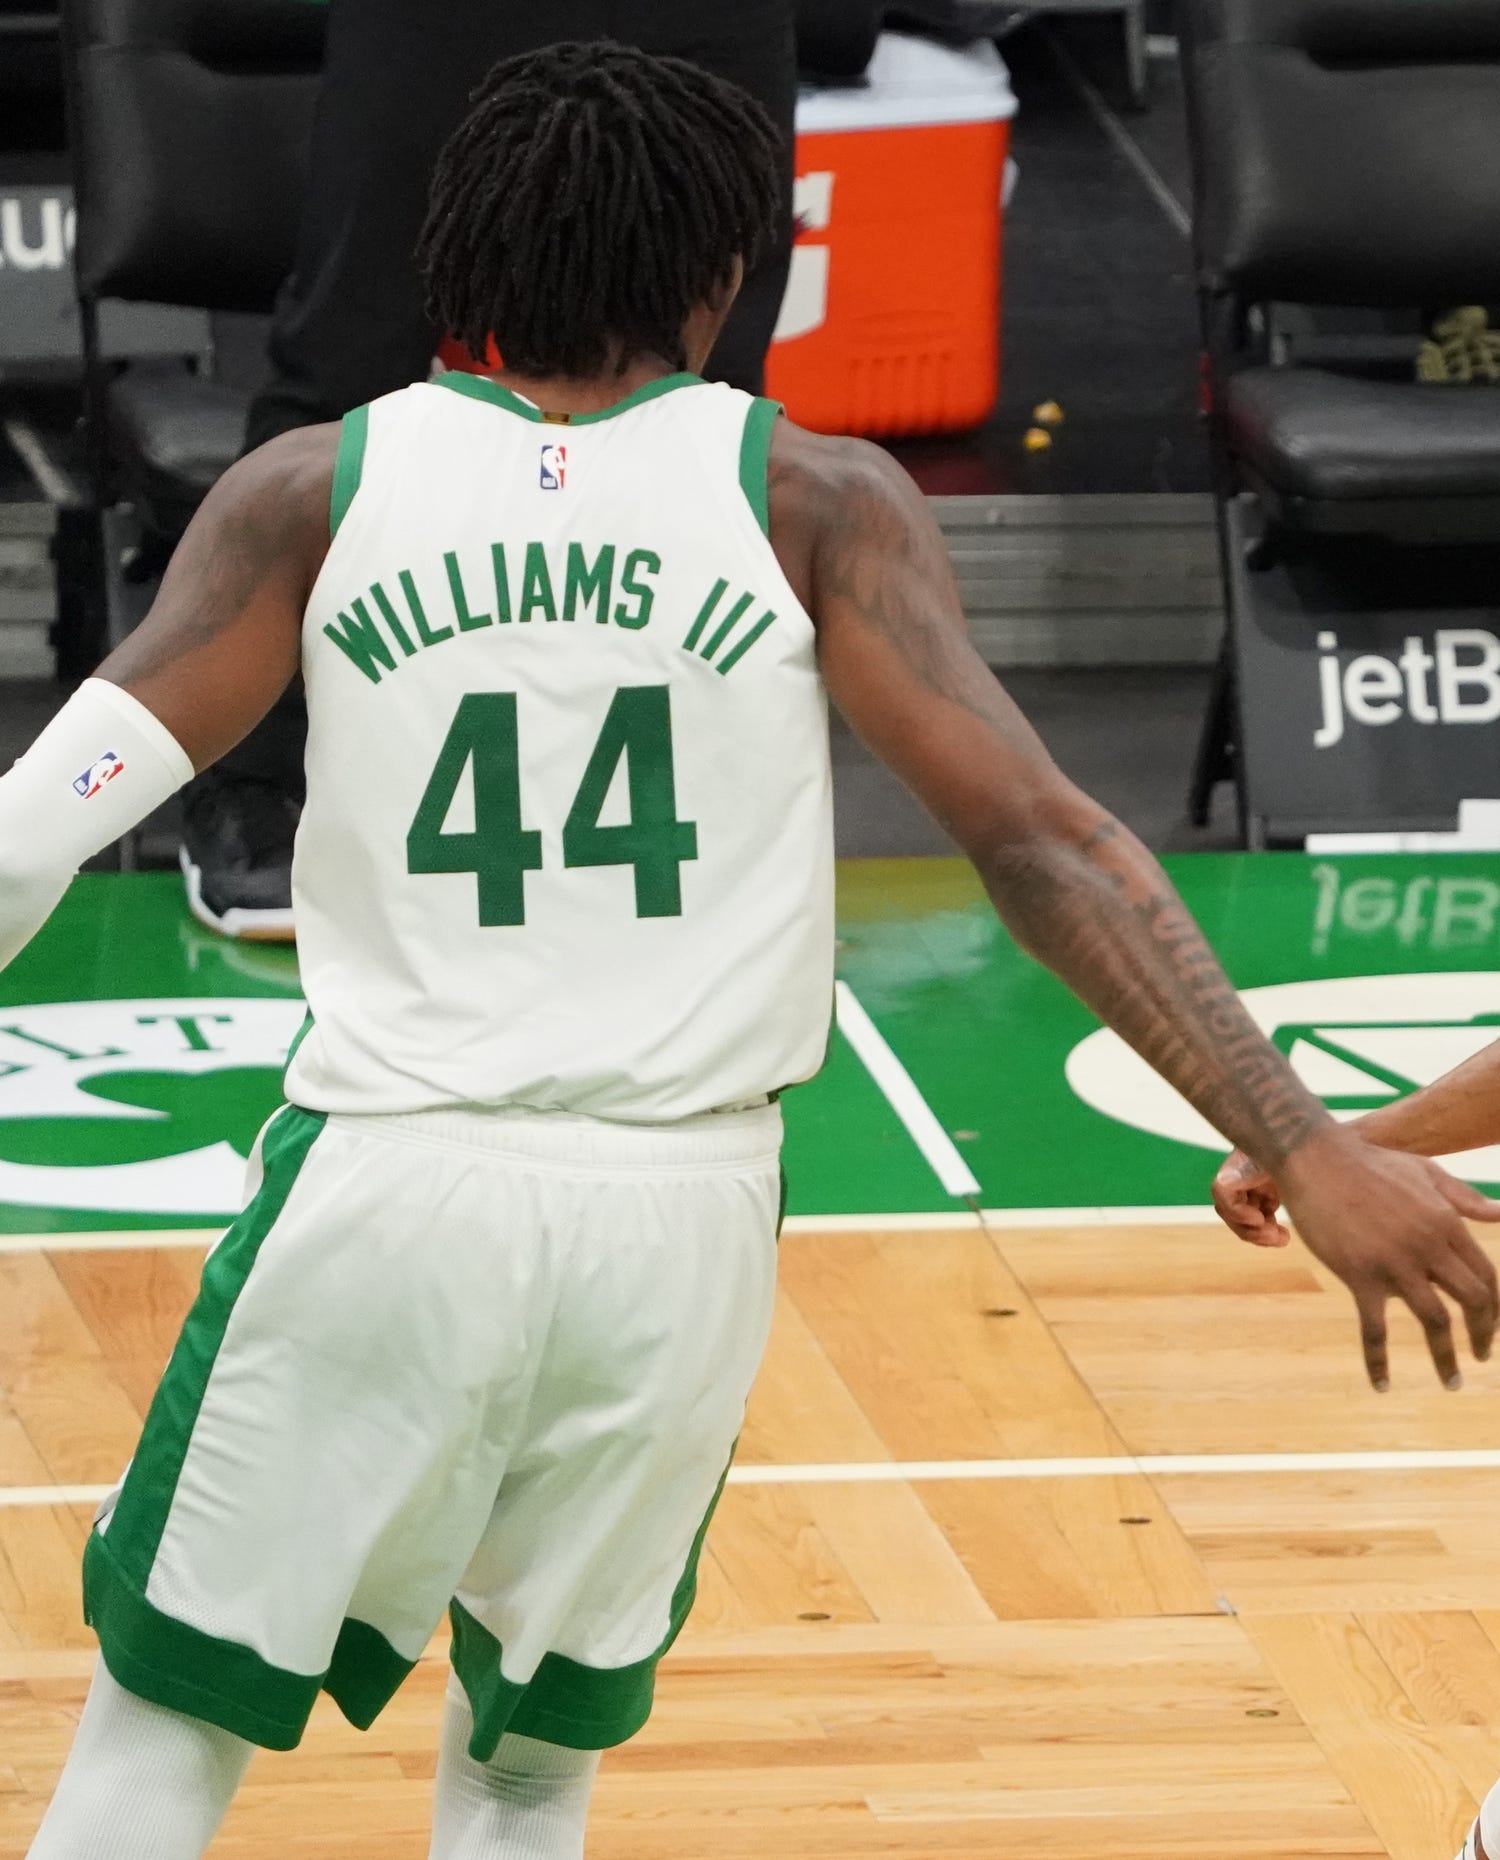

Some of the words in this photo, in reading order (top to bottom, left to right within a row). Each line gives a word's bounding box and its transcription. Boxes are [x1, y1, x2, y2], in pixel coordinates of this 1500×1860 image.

[322, 541, 662, 685] WILLIAMS
[681, 576, 778, 677] III
[406, 683, 699, 928] 44
